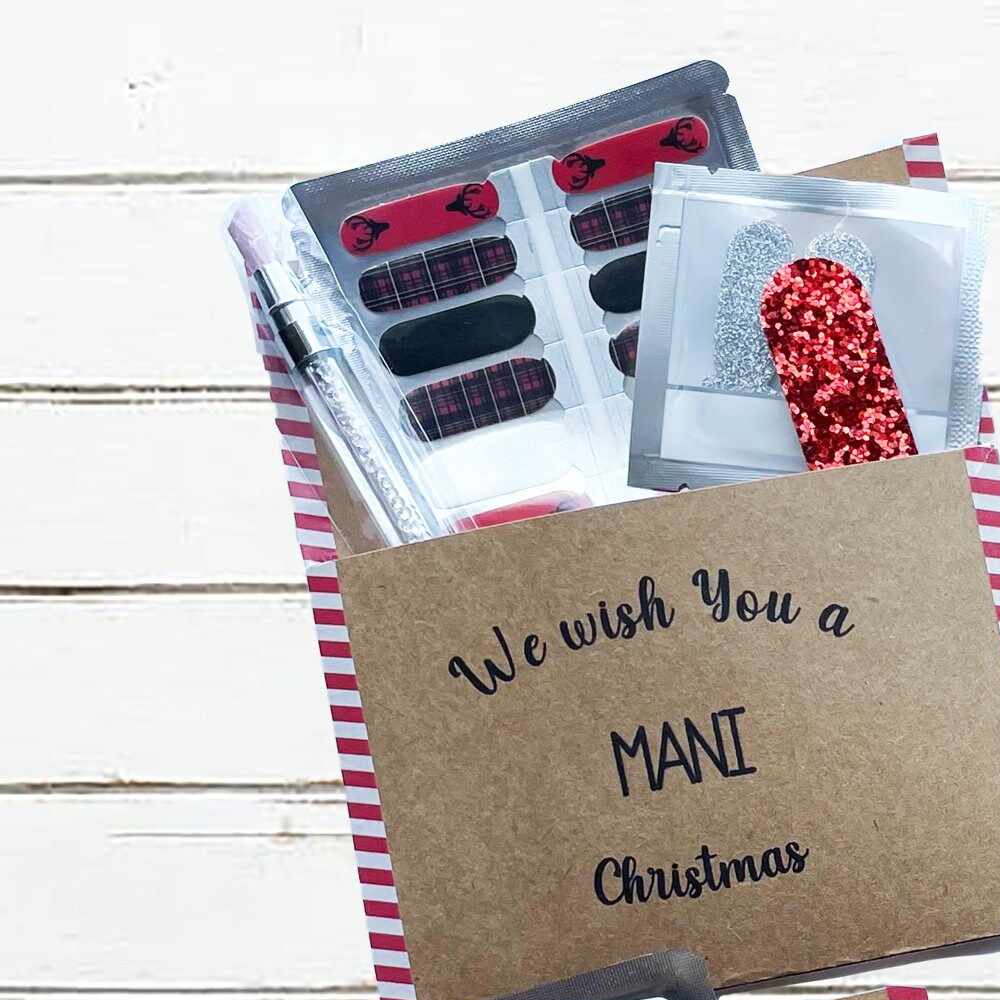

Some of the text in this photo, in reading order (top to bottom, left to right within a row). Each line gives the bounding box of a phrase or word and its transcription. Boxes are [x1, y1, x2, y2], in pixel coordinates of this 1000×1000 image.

[449, 568, 855, 695] We wish You a
[610, 706, 757, 796] MANI
[594, 841, 809, 906] Christmas
